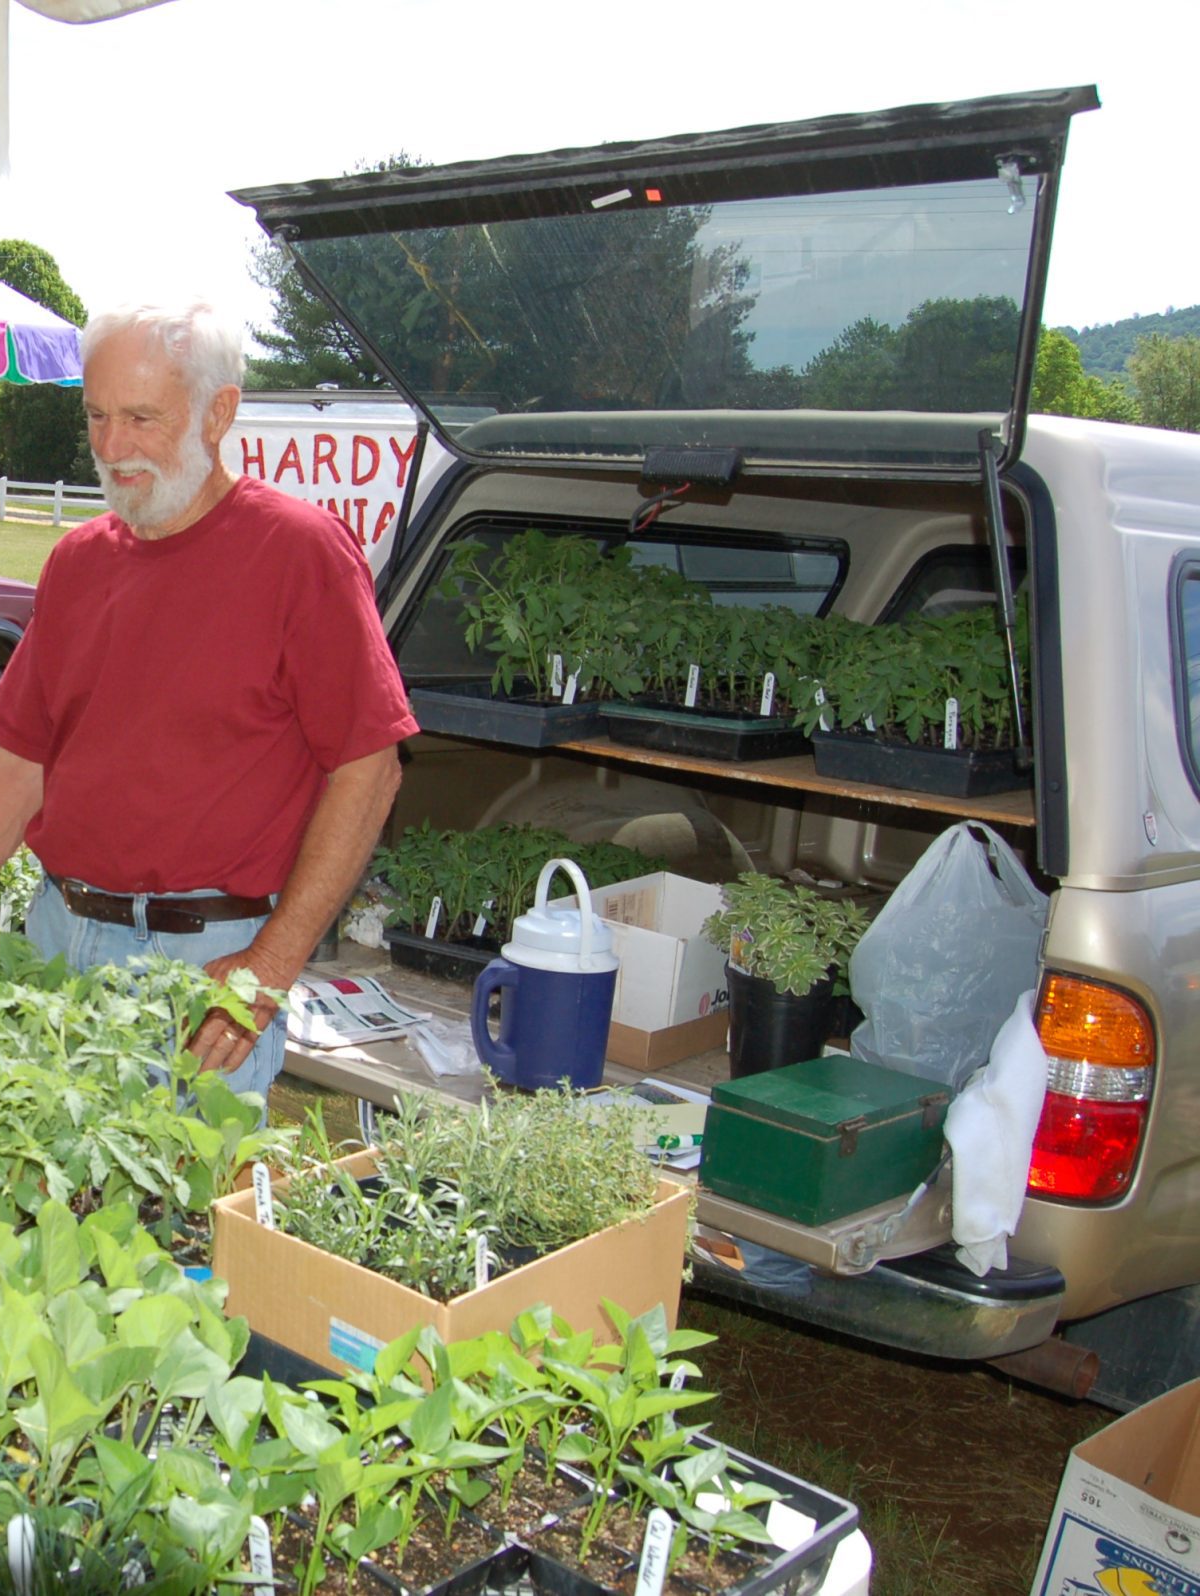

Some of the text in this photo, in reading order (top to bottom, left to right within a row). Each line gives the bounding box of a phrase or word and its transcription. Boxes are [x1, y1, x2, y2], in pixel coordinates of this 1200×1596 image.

[240, 433, 418, 488] HARDY
[255, 1169, 266, 1207] French
[1081, 1491, 1102, 1509] 165
[650, 1520, 667, 1540] Cal
[1120, 1552, 1190, 1594] LEMONS
